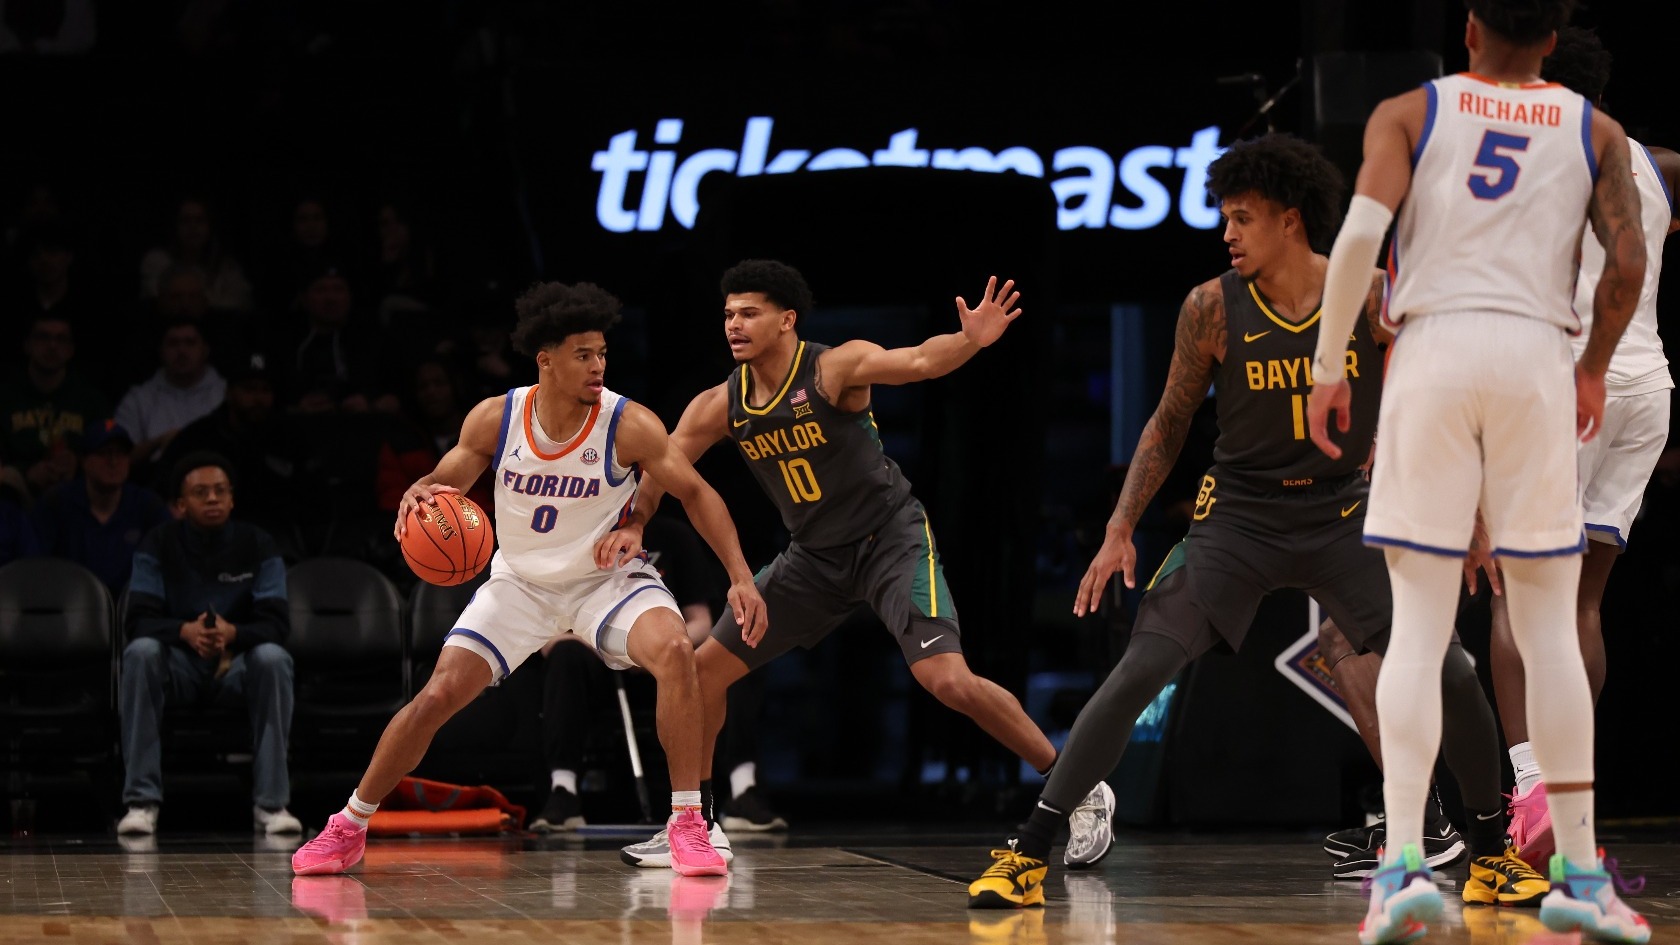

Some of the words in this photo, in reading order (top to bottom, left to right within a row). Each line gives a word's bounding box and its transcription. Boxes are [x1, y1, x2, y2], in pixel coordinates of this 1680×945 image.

[1459, 91, 1561, 127] RICHARD
[1467, 129, 1531, 200] 5
[1245, 349, 1361, 391] BAYLR
[1290, 393, 1312, 440] 1
[739, 421, 828, 461] BAYLOR
[503, 469, 601, 499] FLORIDA
[778, 457, 823, 504] 10
[427, 500, 457, 540] SPALD
[531, 504, 560, 534] 0
